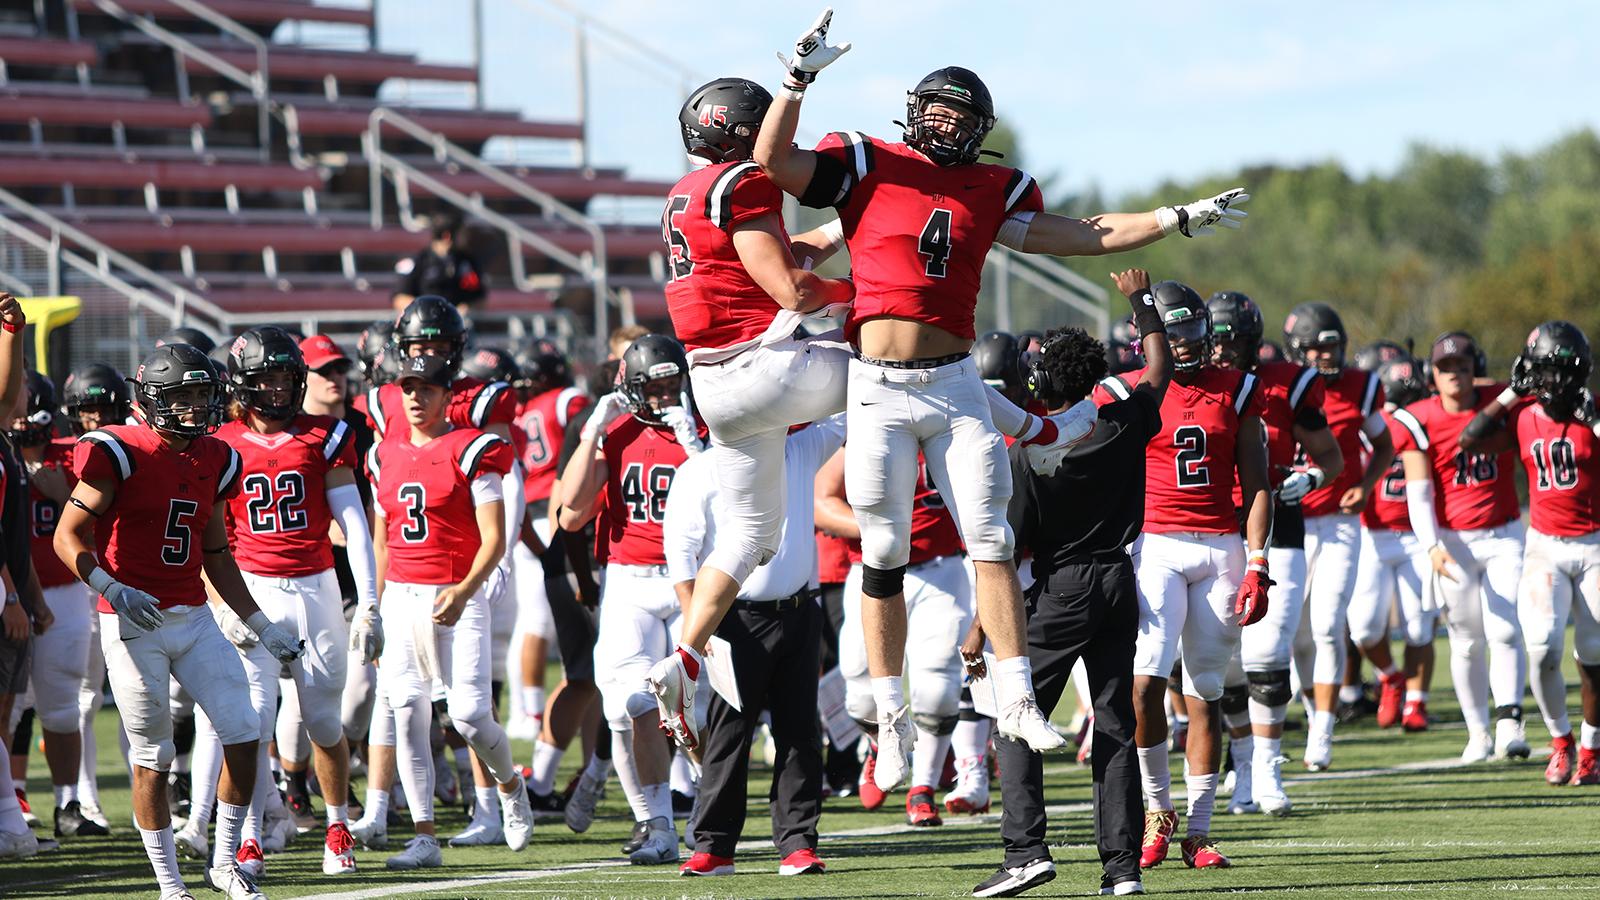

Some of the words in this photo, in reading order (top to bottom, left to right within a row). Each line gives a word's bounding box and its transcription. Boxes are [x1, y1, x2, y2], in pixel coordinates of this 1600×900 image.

[699, 104, 728, 129] 45
[932, 191, 946, 204] RPI
[918, 207, 953, 279] 4
[1182, 410, 1195, 420] RPI
[267, 459, 278, 468] RPI
[644, 448, 656, 458] RPI
[1173, 425, 1210, 488] 2
[1530, 437, 1578, 491] 10
[178, 483, 189, 493] RPI
[408, 469, 419, 478] RPI
[621, 462, 679, 523] 48
[243, 470, 308, 534] 22
[399, 482, 430, 543] 3
[161, 498, 198, 566] 5
